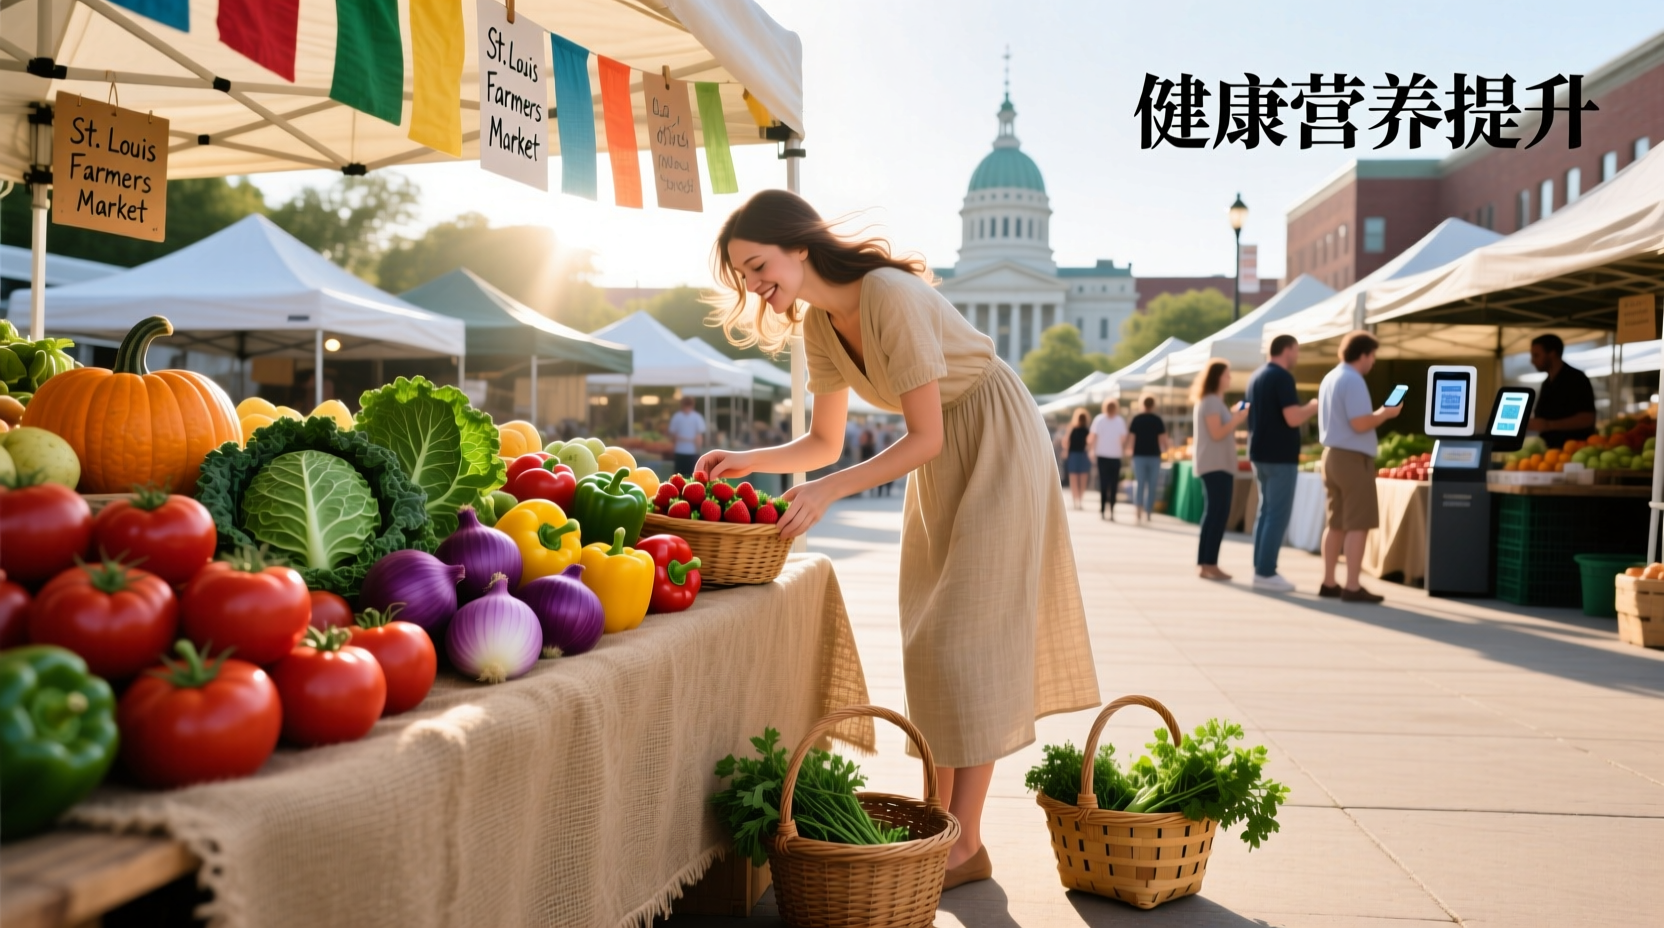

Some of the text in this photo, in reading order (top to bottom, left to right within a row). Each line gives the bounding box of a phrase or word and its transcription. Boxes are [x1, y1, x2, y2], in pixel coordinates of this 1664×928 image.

[481, 27, 507, 64] St.
[487, 70, 542, 122] Farmers
[70, 116, 156, 162] St. Louis
[489, 115, 540, 162] Market
[70, 152, 152, 194] Farmers
[76, 188, 148, 224] Market
